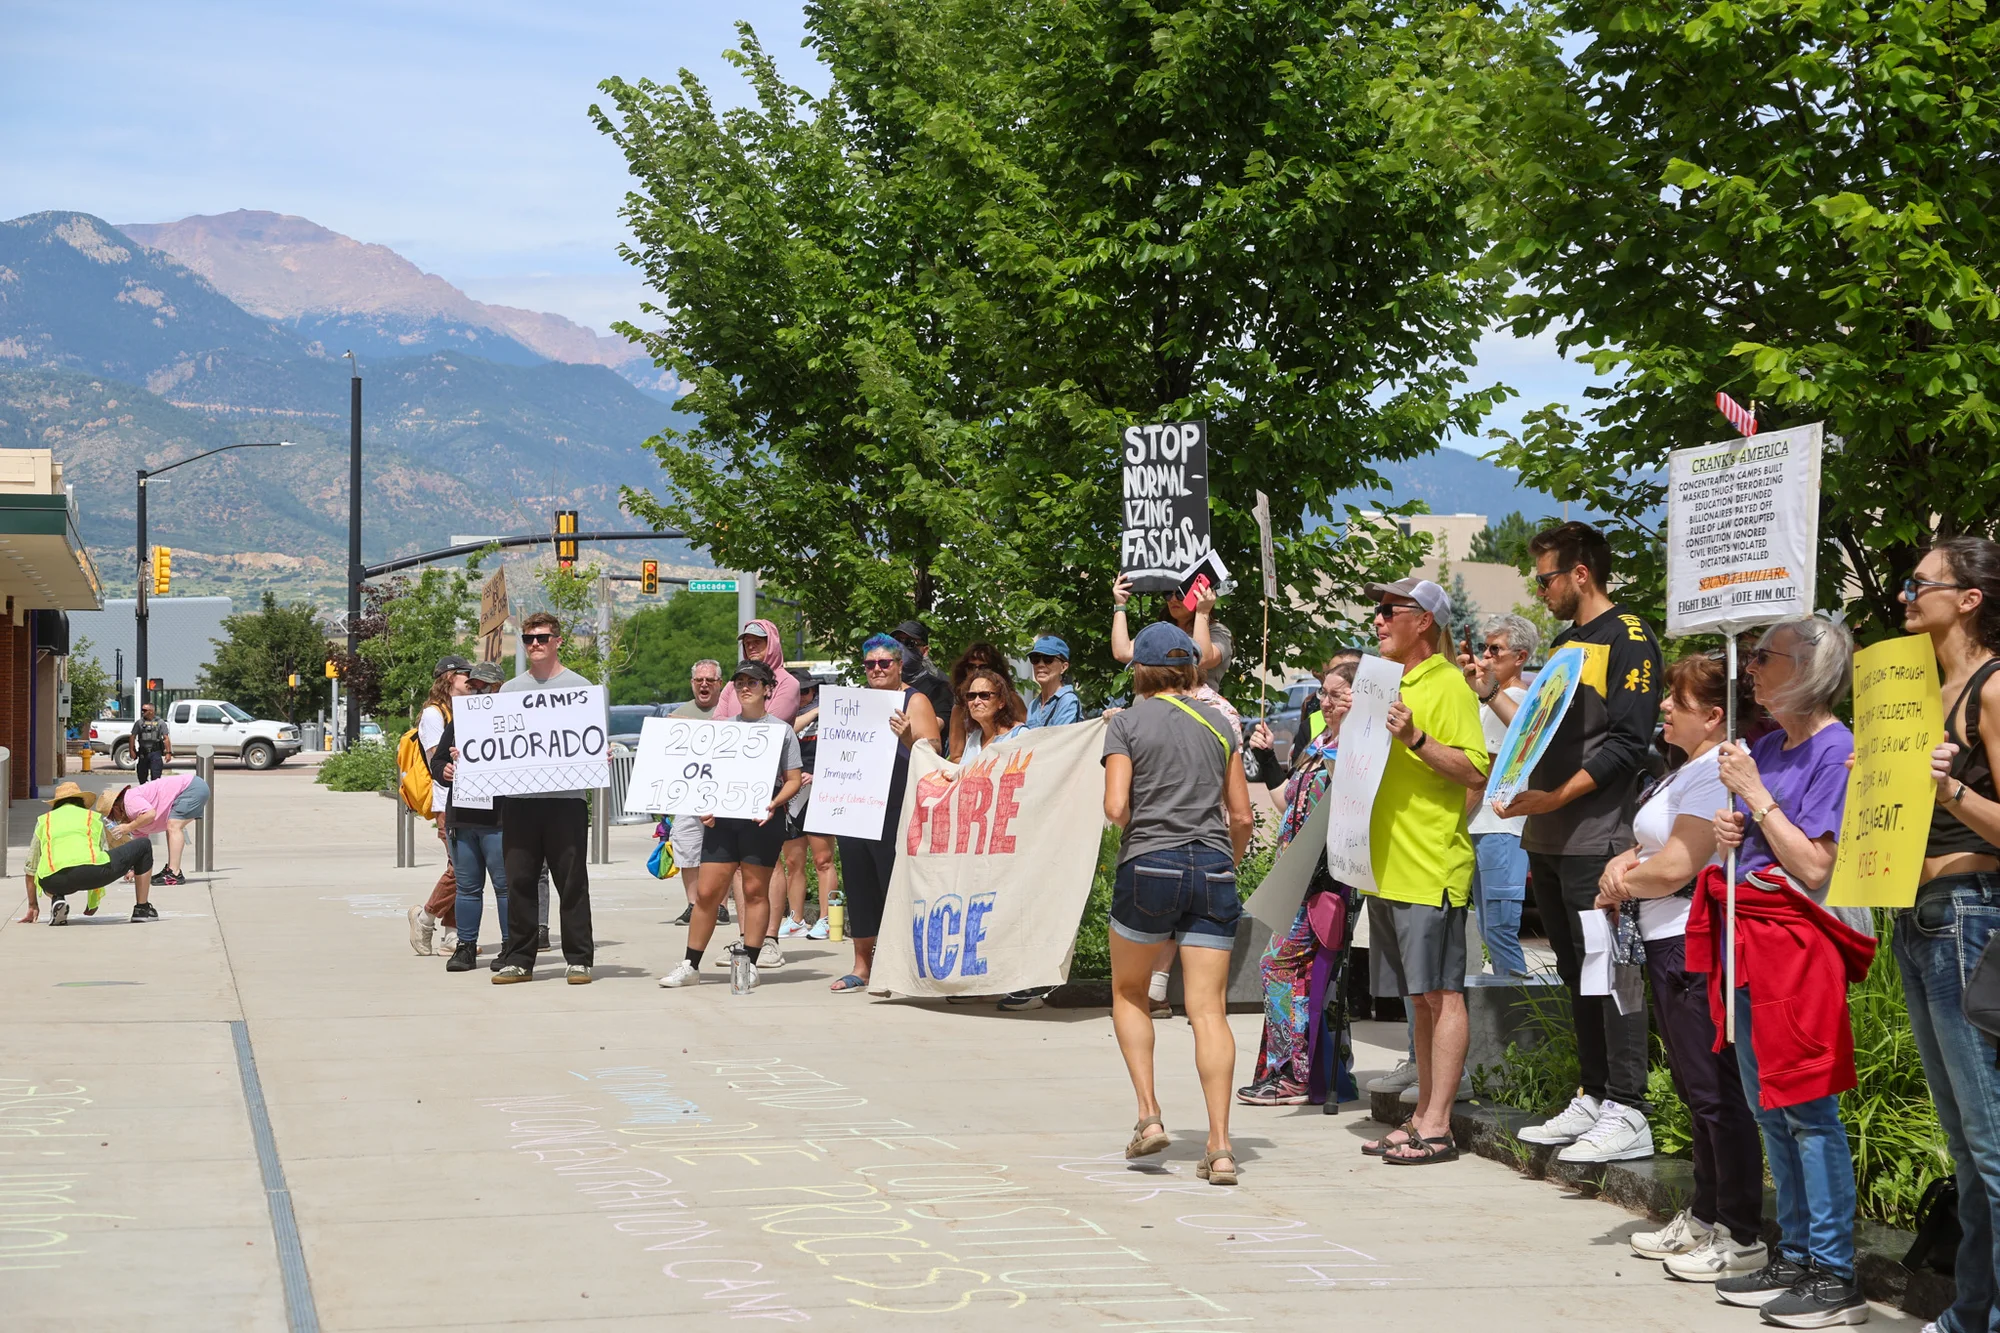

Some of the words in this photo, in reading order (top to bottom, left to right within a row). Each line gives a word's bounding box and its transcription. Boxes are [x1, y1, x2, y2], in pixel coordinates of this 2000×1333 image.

[1125, 424, 1200, 464] STOP
[1692, 453, 1736, 473] CRANK's
[1740, 441, 1789, 463] AMERICA
[1679, 473, 1735, 492] CONCENTRATION
[1737, 468, 1761, 480] CAMPS
[1764, 463, 1783, 475] BUILT
[1682, 491, 1710, 503] MASKED
[1711, 484, 1734, 497] THUGS
[1737, 475, 1783, 491] TERRORIZING
[1125, 499, 1174, 529] IZING
[1689, 508, 1732, 524] BILLIONAIRES
[1735, 503, 1758, 514] PAYED
[1760, 500, 1773, 511] OFF
[1695, 498, 1733, 512] EDUCATION
[1736, 489, 1773, 501] DEFUNDED
[1685, 532, 1732, 548] CONSTITUTION
[1733, 527, 1767, 540] IGNORED
[1690, 524, 1706, 536] RULE
[1707, 523, 1716, 532] OF
[1717, 520, 1732, 531] LAW
[1734, 512, 1775, 527] CORRUPTED
[1122, 517, 1210, 568] FASCISM
[1689, 548, 1706, 559] CIVIL
[1707, 544, 1731, 556] RIGHTS
[1733, 539, 1767, 551] VIOLATED
[1700, 556, 1730, 568] DICTATOR
[1731, 550, 1769, 563] INSTALLED
[690, 581, 727, 590] Cascade
[1678, 599, 1700, 612] FIGHT
[1701, 594, 1723, 608] BACK!
[1731, 591, 1752, 604] VOTE
[1755, 589, 1772, 601] HIM
[1775, 586, 1796, 599] OUT!
[1641, 659, 1652, 694] vivo
[1890, 665, 1926, 680] THROUGH
[467, 695, 493, 710] NO
[522, 690, 588, 709] CAMPS
[834, 698, 861, 726] Fight
[493, 713, 525, 734] IN
[822, 727, 876, 743] IGNORANCE
[1363, 715, 1372, 738] A
[462, 725, 605, 763] COLORADO
[665, 722, 770, 759] 2025
[1882, 736, 1910, 753] GROWS
[1916, 732, 1929, 752] UP
[683, 762, 713, 779] OR
[840, 751, 857, 763] NOT
[1344, 750, 1372, 780] MAGA
[646, 780, 769, 814] 1935?
[907, 756, 1028, 856] FIRE
[913, 892, 996, 981] ICE
[690, 1057, 868, 1110] DEFEND
[475, 1094, 603, 1114] NO
[611, 1121, 821, 1165] DUE
[801, 1118, 960, 1153] THE
[505, 1118, 723, 1251] CONCENTRATION
[711, 1181, 1026, 1313] PROCESS
[853, 1163, 1254, 1333] CONSTITUTI
